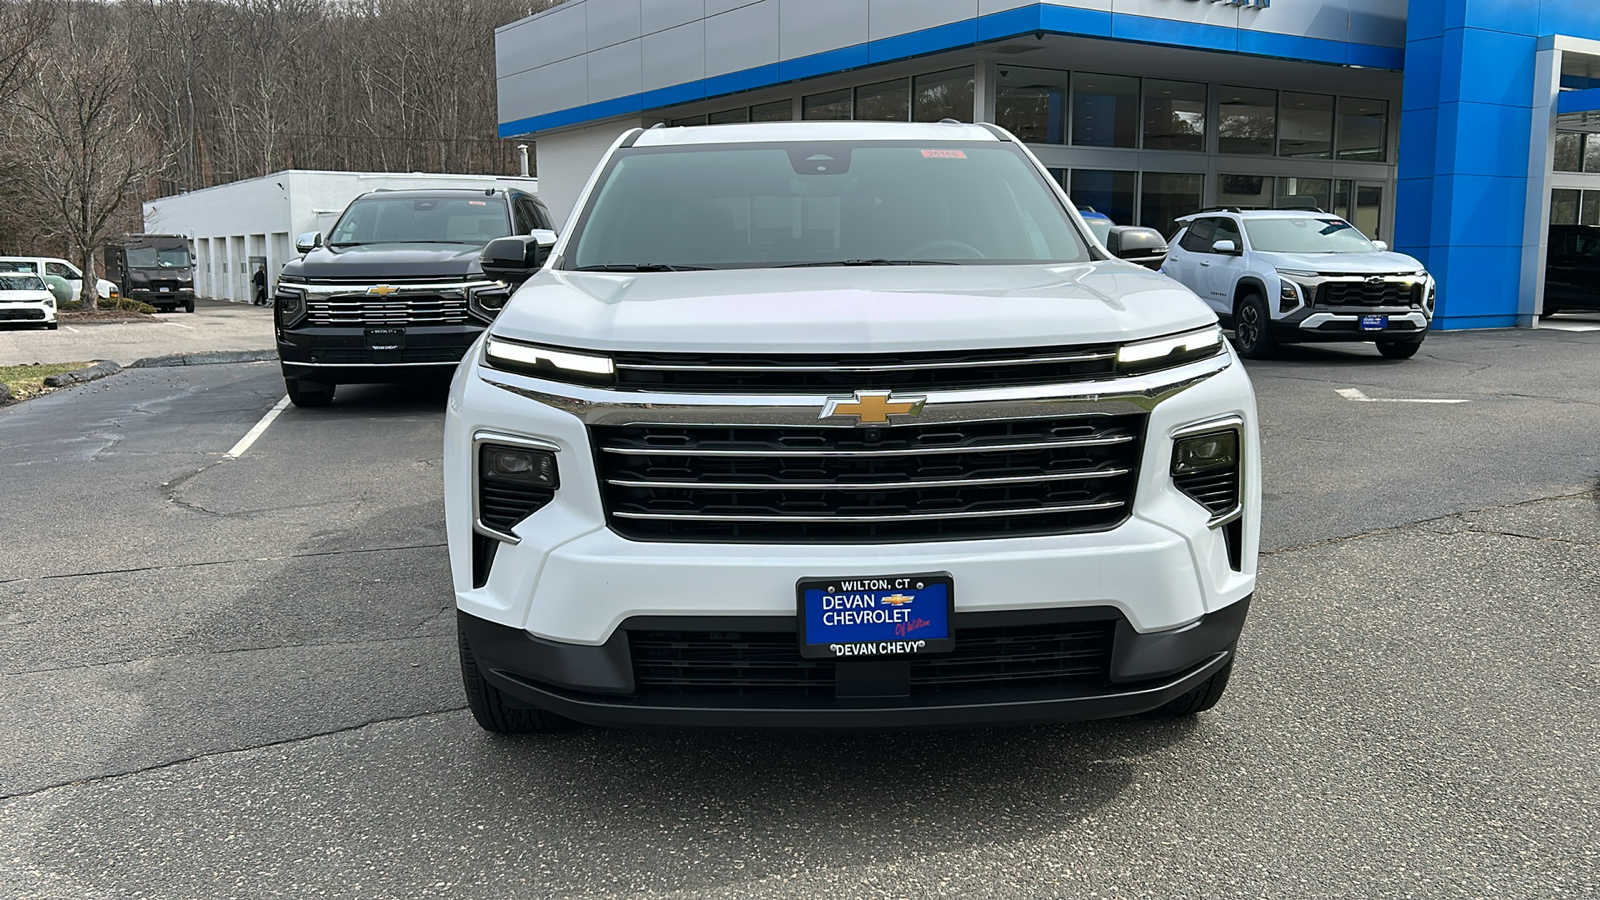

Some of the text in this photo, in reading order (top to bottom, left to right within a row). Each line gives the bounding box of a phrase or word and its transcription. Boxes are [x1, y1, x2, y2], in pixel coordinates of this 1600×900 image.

[841, 578, 911, 591] WILTON, CT
[822, 594, 875, 610] DEVAN
[822, 608, 911, 626] CHEVROLET
[895, 618, 930, 637] Of Wilton
[836, 641, 919, 656] DEVAN CHEVY
